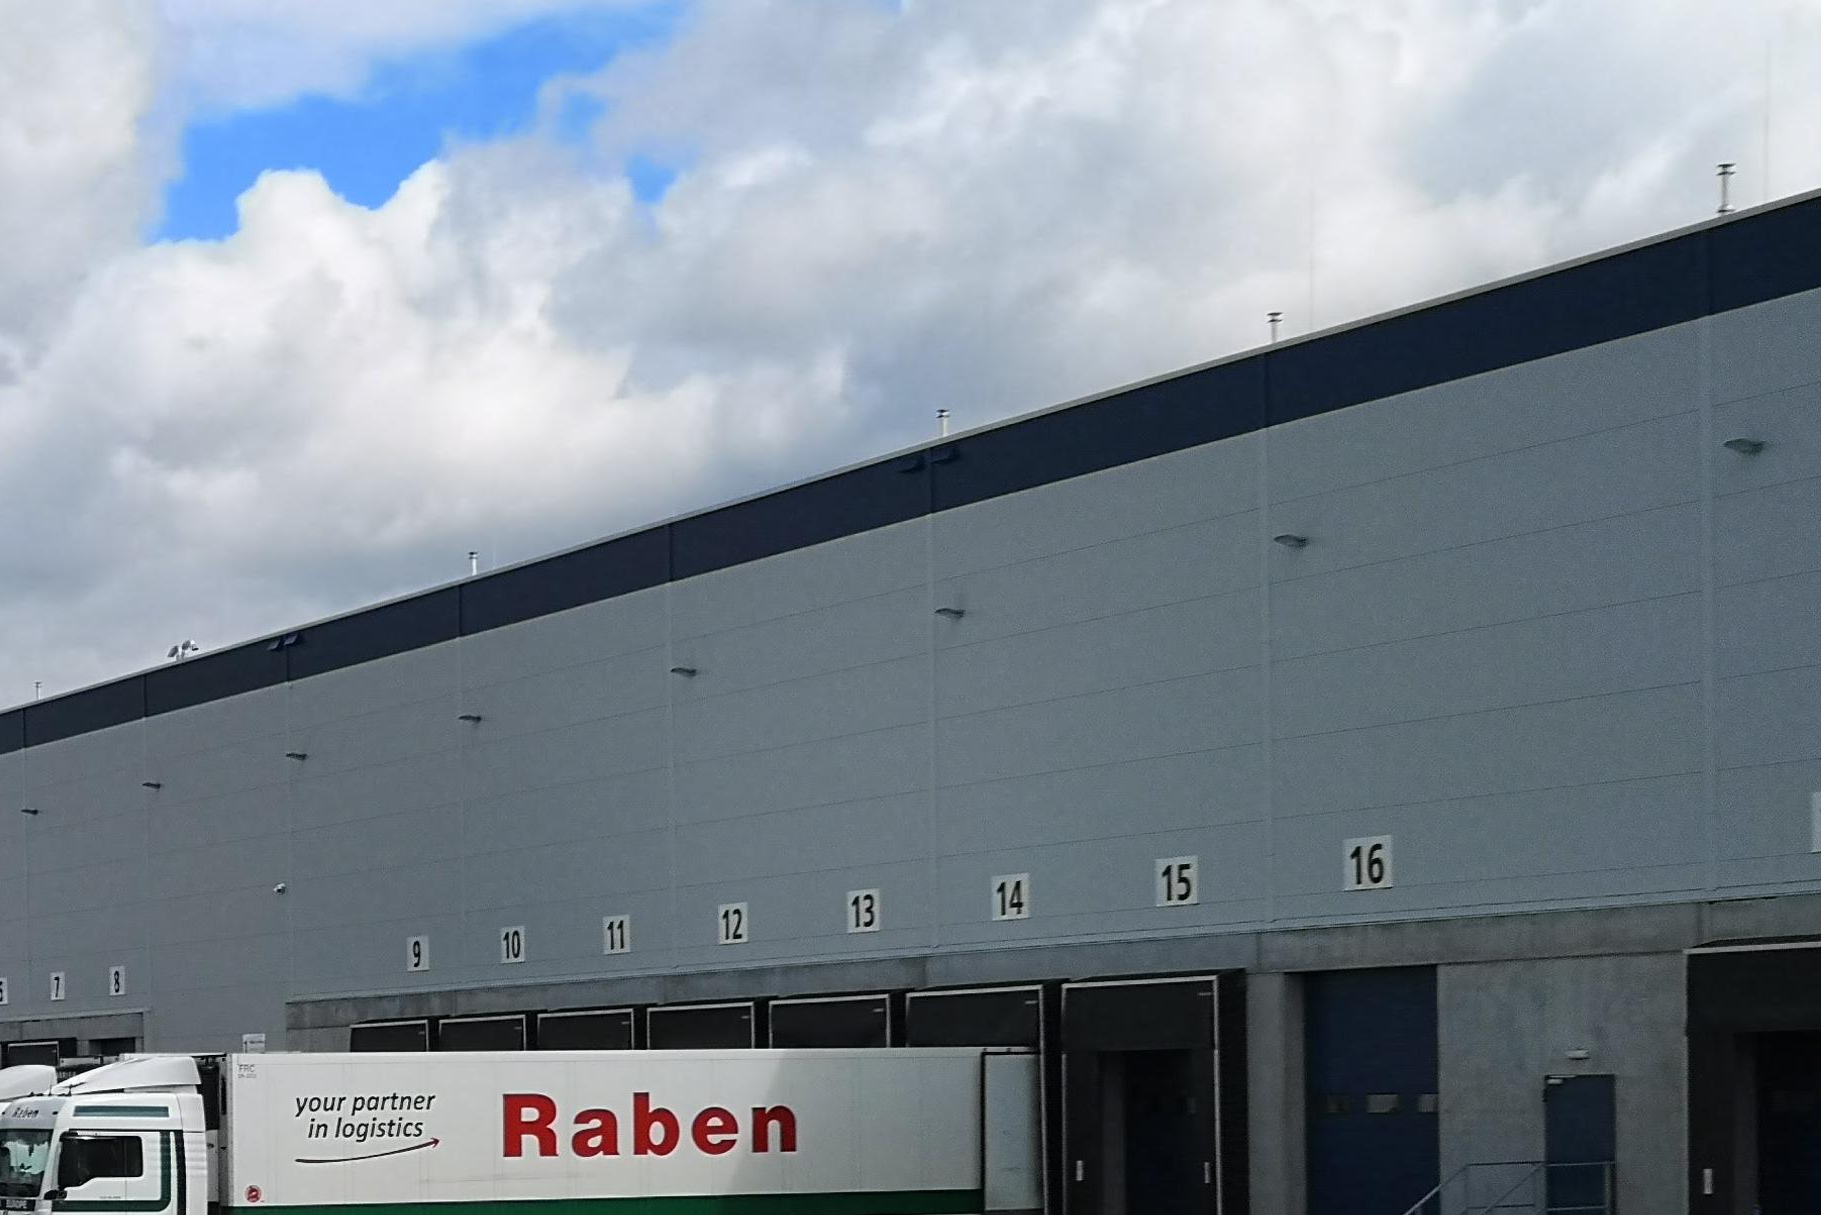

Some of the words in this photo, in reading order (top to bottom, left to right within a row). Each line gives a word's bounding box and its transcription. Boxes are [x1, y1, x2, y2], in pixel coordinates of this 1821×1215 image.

[1349, 843, 1386, 885] 16
[1161, 863, 1192, 901] 15
[851, 893, 875, 928] 13
[996, 880, 1024, 916] 14
[607, 919, 626, 950] 11
[722, 908, 743, 940] 12
[412, 940, 421, 968] 9
[502, 930, 521, 960] 10
[53, 976, 61, 998] 7
[113, 970, 120, 993] 8
[295, 1096, 346, 1117] your
[351, 1092, 436, 1116] partner
[308, 1118, 328, 1138] in
[335, 1117, 423, 1142] logistics
[502, 1091, 797, 1158] Raben
